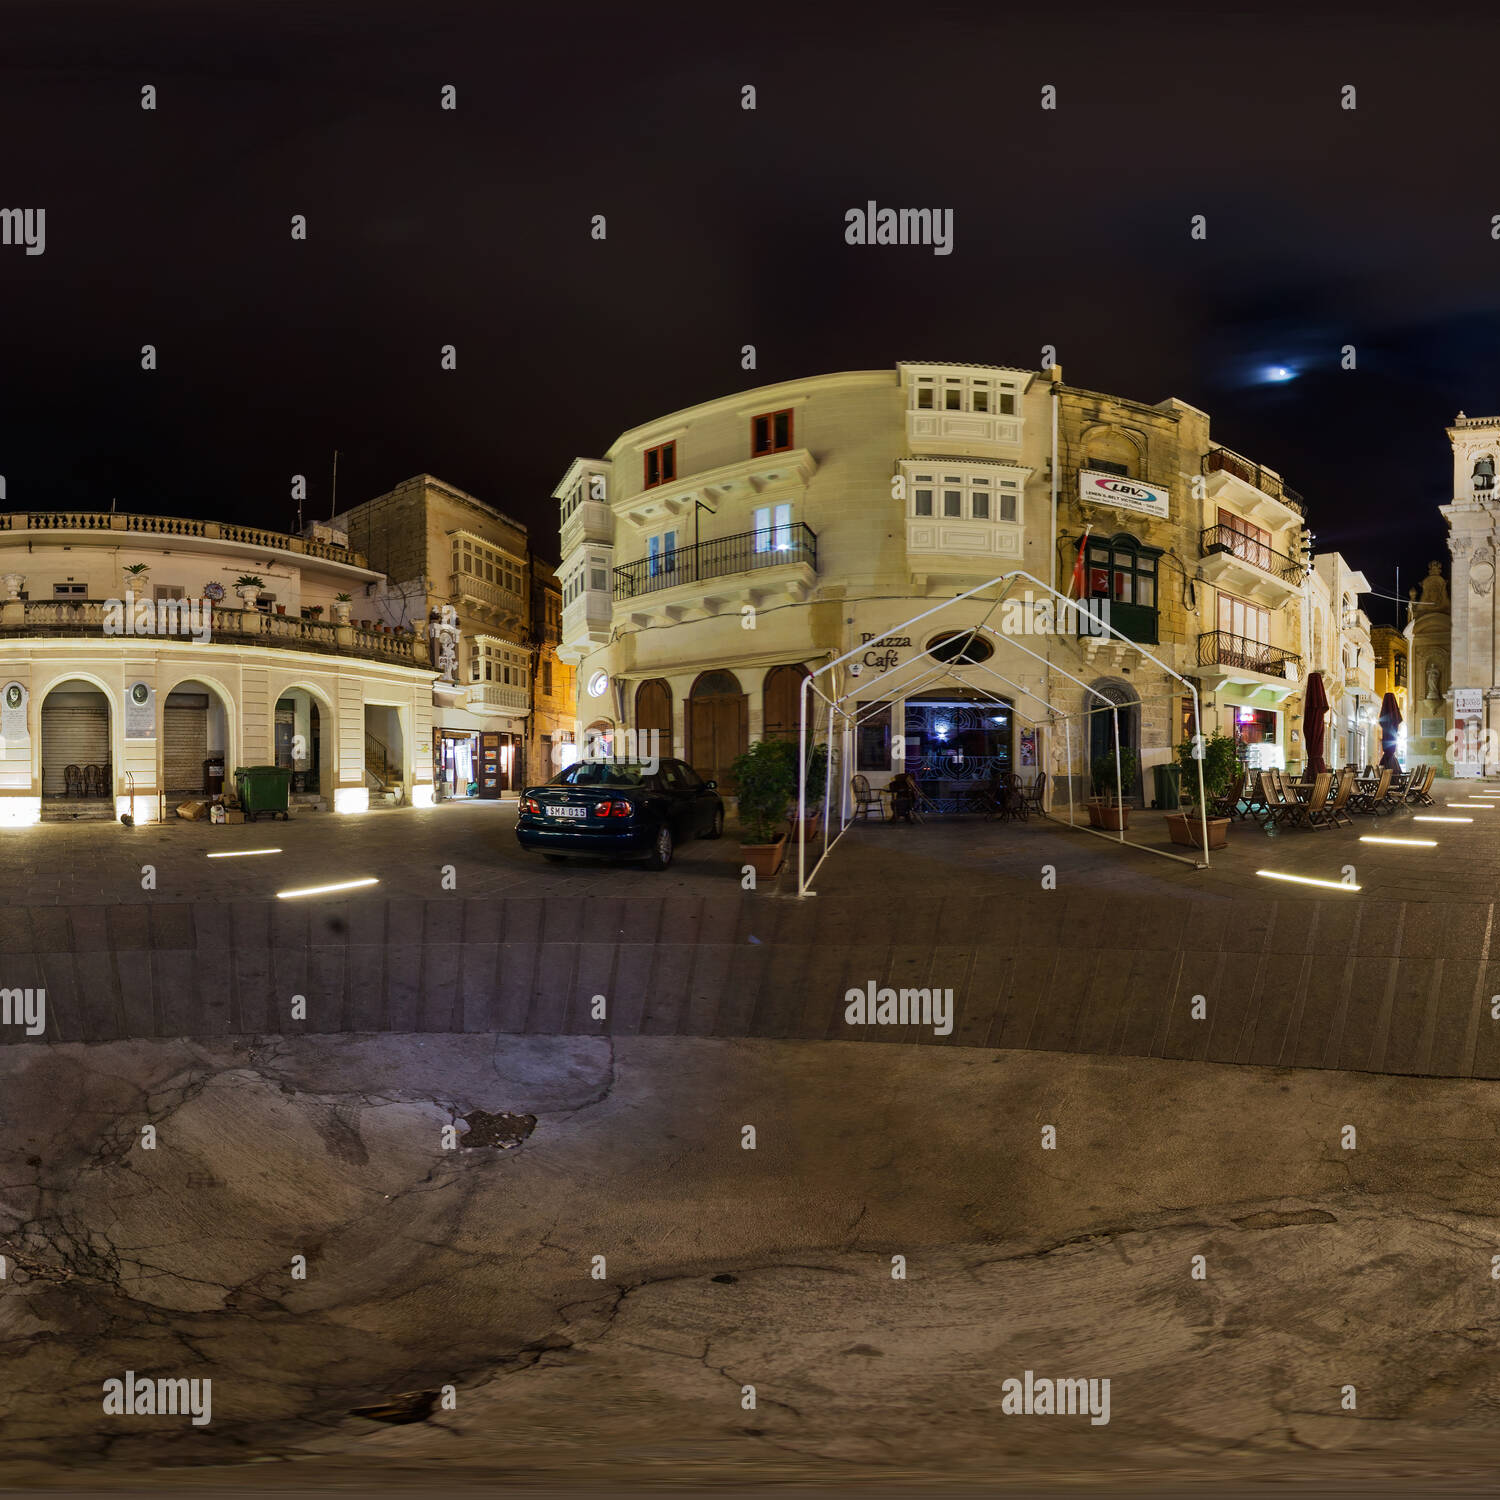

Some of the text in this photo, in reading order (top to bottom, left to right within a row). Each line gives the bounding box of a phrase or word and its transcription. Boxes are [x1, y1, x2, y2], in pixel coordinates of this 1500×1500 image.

[1112, 484, 1141, 496] LBV
[861, 633, 912, 647] Piazza
[863, 649, 899, 672] Café
